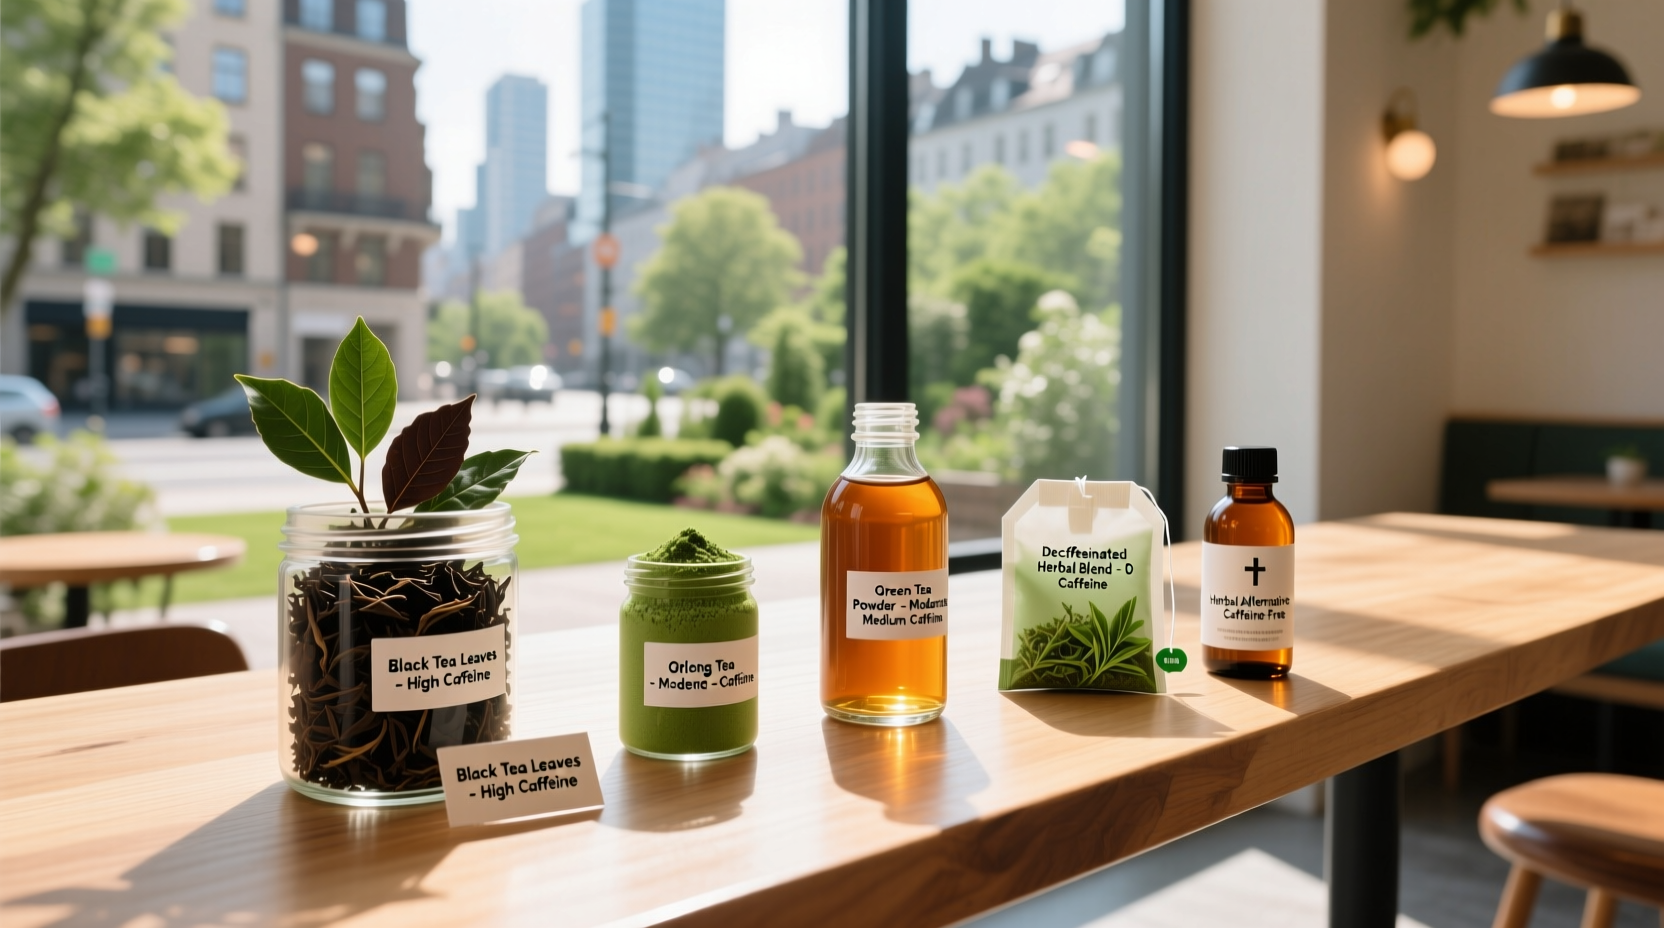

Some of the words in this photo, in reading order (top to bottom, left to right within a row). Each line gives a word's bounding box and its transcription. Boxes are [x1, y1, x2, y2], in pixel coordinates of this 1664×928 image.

[1038, 561, 1076, 574] Herbal
[1079, 562, 1112, 575] Blend
[1058, 577, 1108, 589] Caffeine
[853, 599, 896, 611] Powder
[388, 656, 429, 673] Black
[432, 655, 457, 669] Tea
[461, 650, 497, 666] Leaves
[715, 660, 735, 672] Tea
[407, 675, 439, 692] High
[456, 763, 497, 782] Black
[500, 762, 528, 776] Tea
[531, 756, 581, 773] Leaves
[481, 782, 514, 801] High
[518, 776, 578, 793] Caffeine
